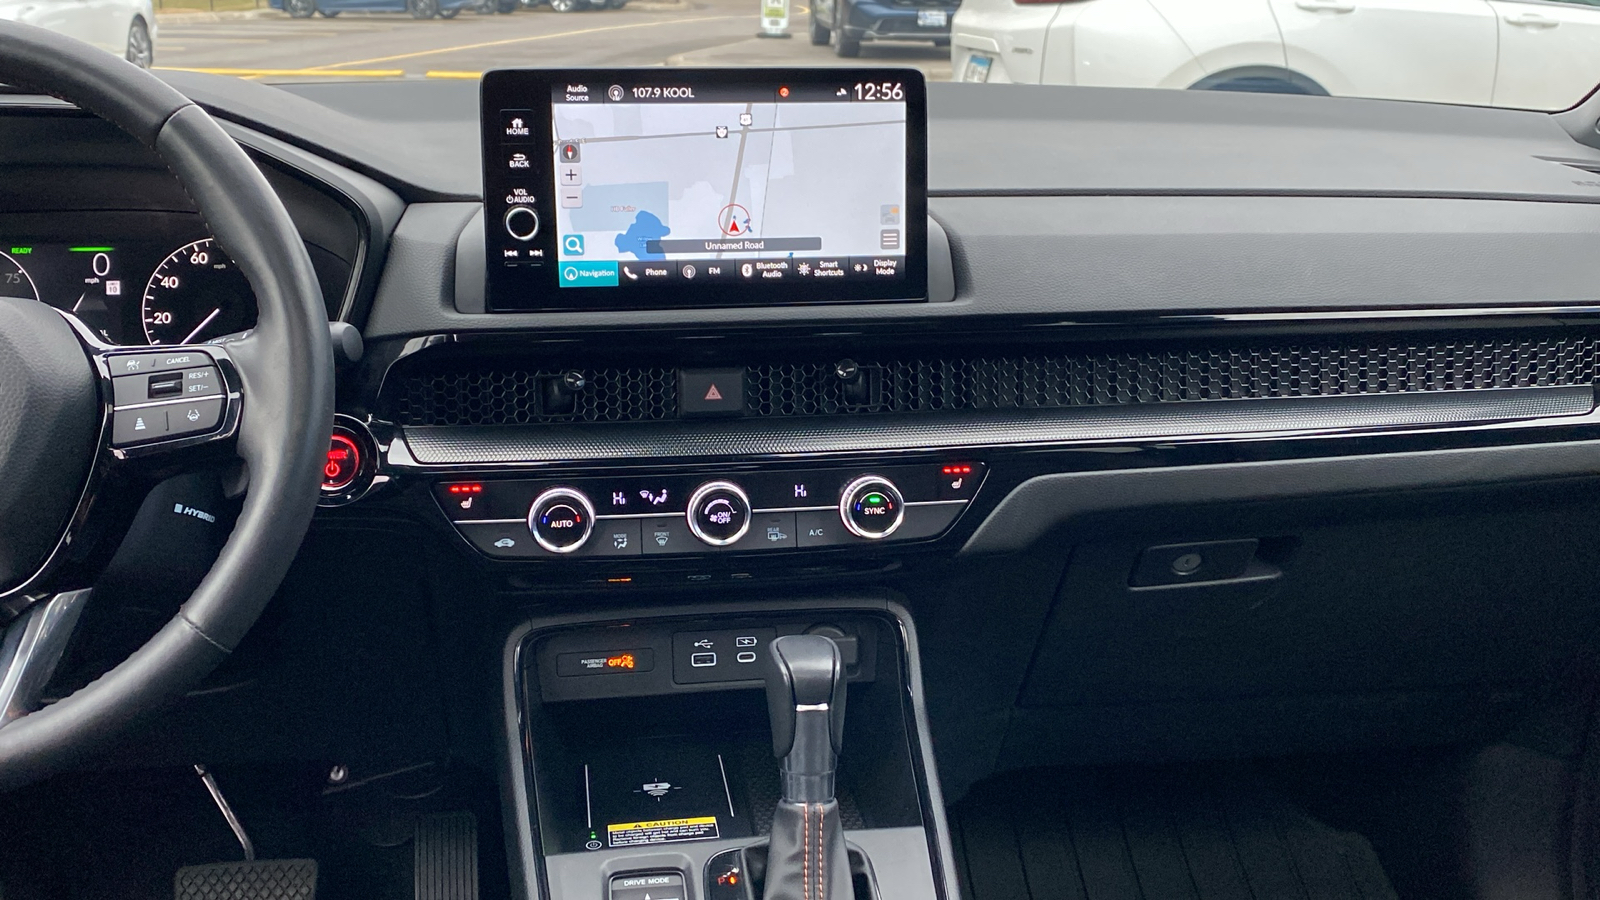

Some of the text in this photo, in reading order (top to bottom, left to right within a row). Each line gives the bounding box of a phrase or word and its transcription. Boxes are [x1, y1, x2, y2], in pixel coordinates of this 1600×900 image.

[566, 85, 588, 93] Audio
[632, 87, 695, 98] 107.9 KOOL
[853, 83, 903, 100] 12:56
[565, 94, 589, 102] Source
[506, 128, 529, 136] HOME
[509, 160, 530, 168] BACK
[705, 240, 765, 251] Unnamed Road
[190, 252, 208, 264] 60
[93, 252, 110, 276] 0
[756, 261, 788, 270] Bluetooth
[819, 260, 838, 268] Smart
[873, 259, 897, 268] Display
[579, 269, 615, 279] Navigation
[645, 267, 668, 276] Phone
[708, 267, 721, 275] FM
[762, 270, 782, 278] Audio
[814, 268, 844, 277] Shortcuts
[876, 267, 895, 275] Mode
[4, 273, 21, 284] 75
[84, 277, 100, 285] mph
[160, 276, 179, 288] 40
[153, 312, 172, 324] 20
[166, 356, 191, 365] CANCEL
[188, 372, 209, 380] RES/+
[183, 506, 216, 523] HYBRID
[864, 507, 886, 515] SYNC
[550, 519, 573, 528] AUTO
[608, 658, 622, 666] OFF
[645, 819, 689, 827] CAUTION
[623, 877, 670, 887] DRIVE MODE
